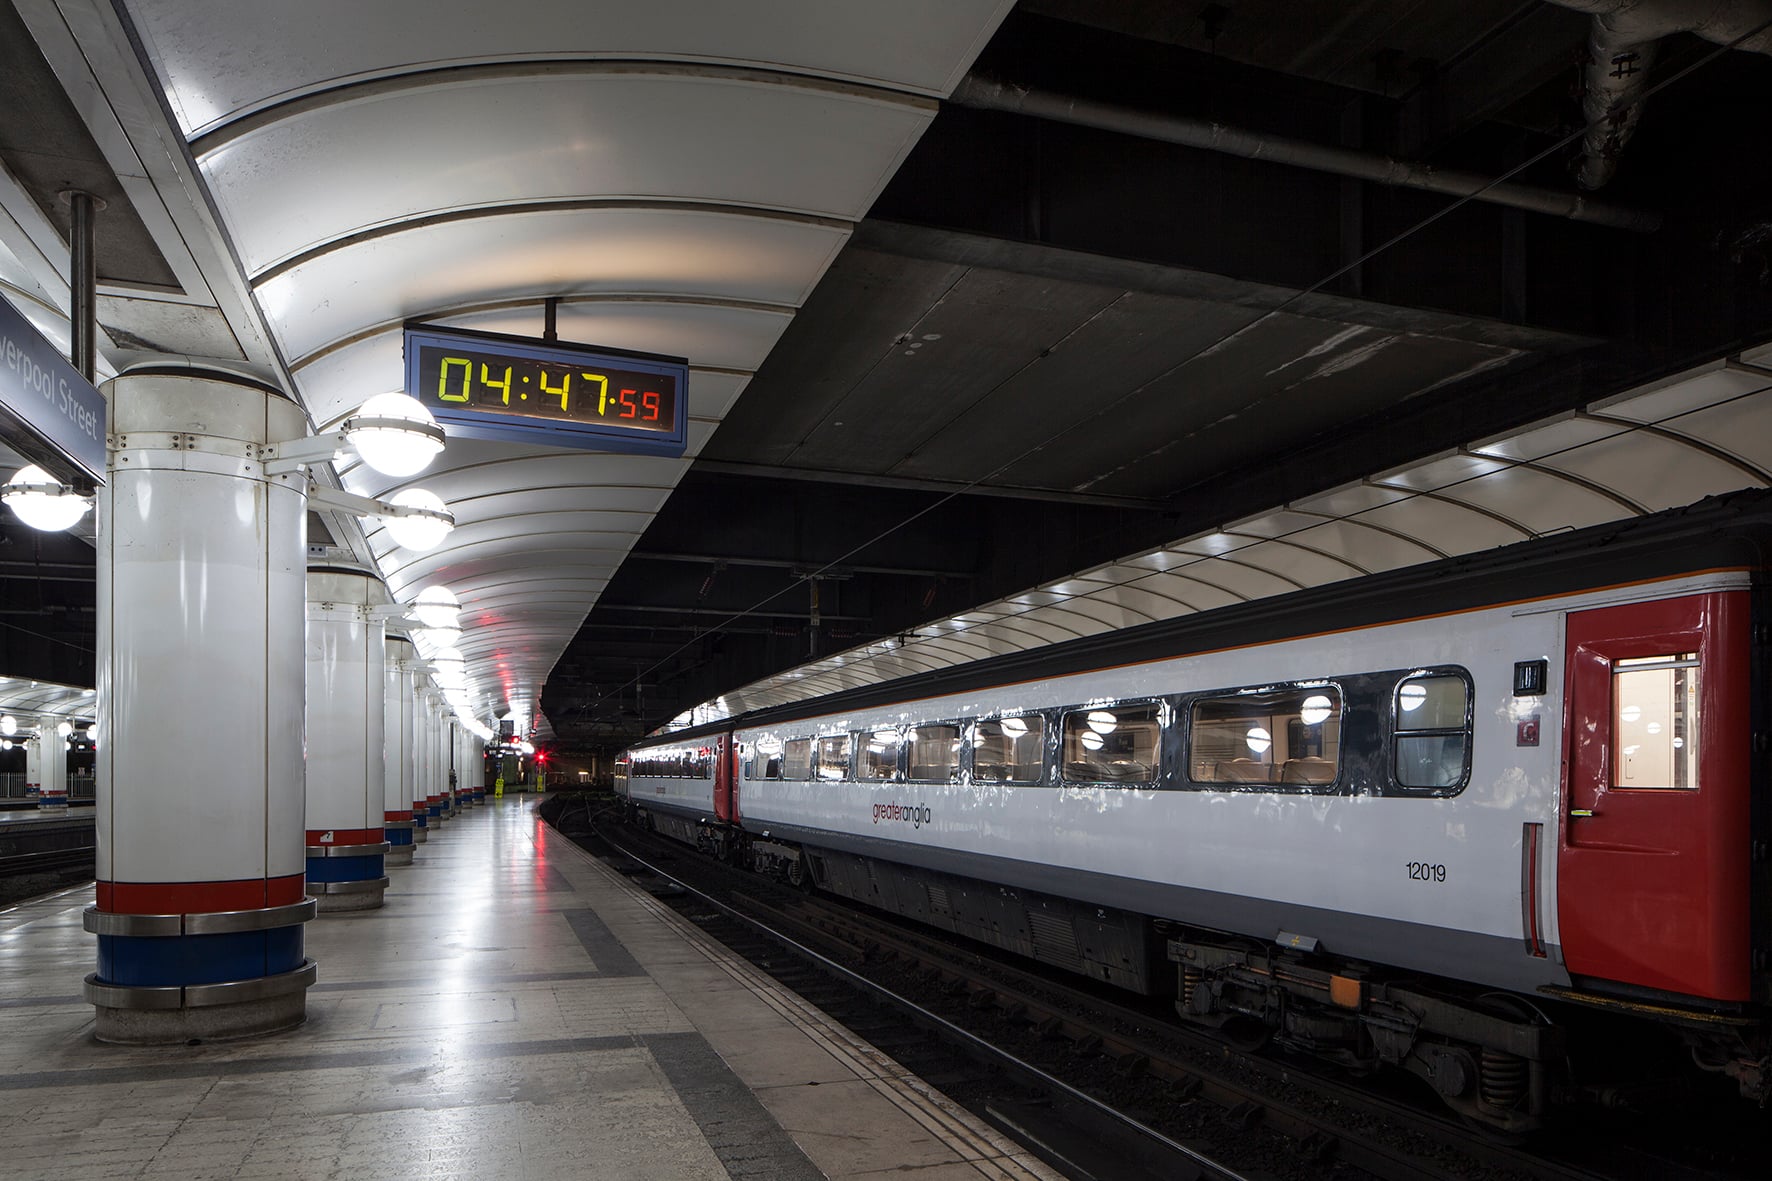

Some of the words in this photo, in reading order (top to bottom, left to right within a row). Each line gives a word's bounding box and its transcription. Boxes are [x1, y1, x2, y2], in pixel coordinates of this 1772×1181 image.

[59, 378, 97, 440] Street
[873, 801, 931, 829] greateranglia
[1406, 862, 1446, 882] 12019
